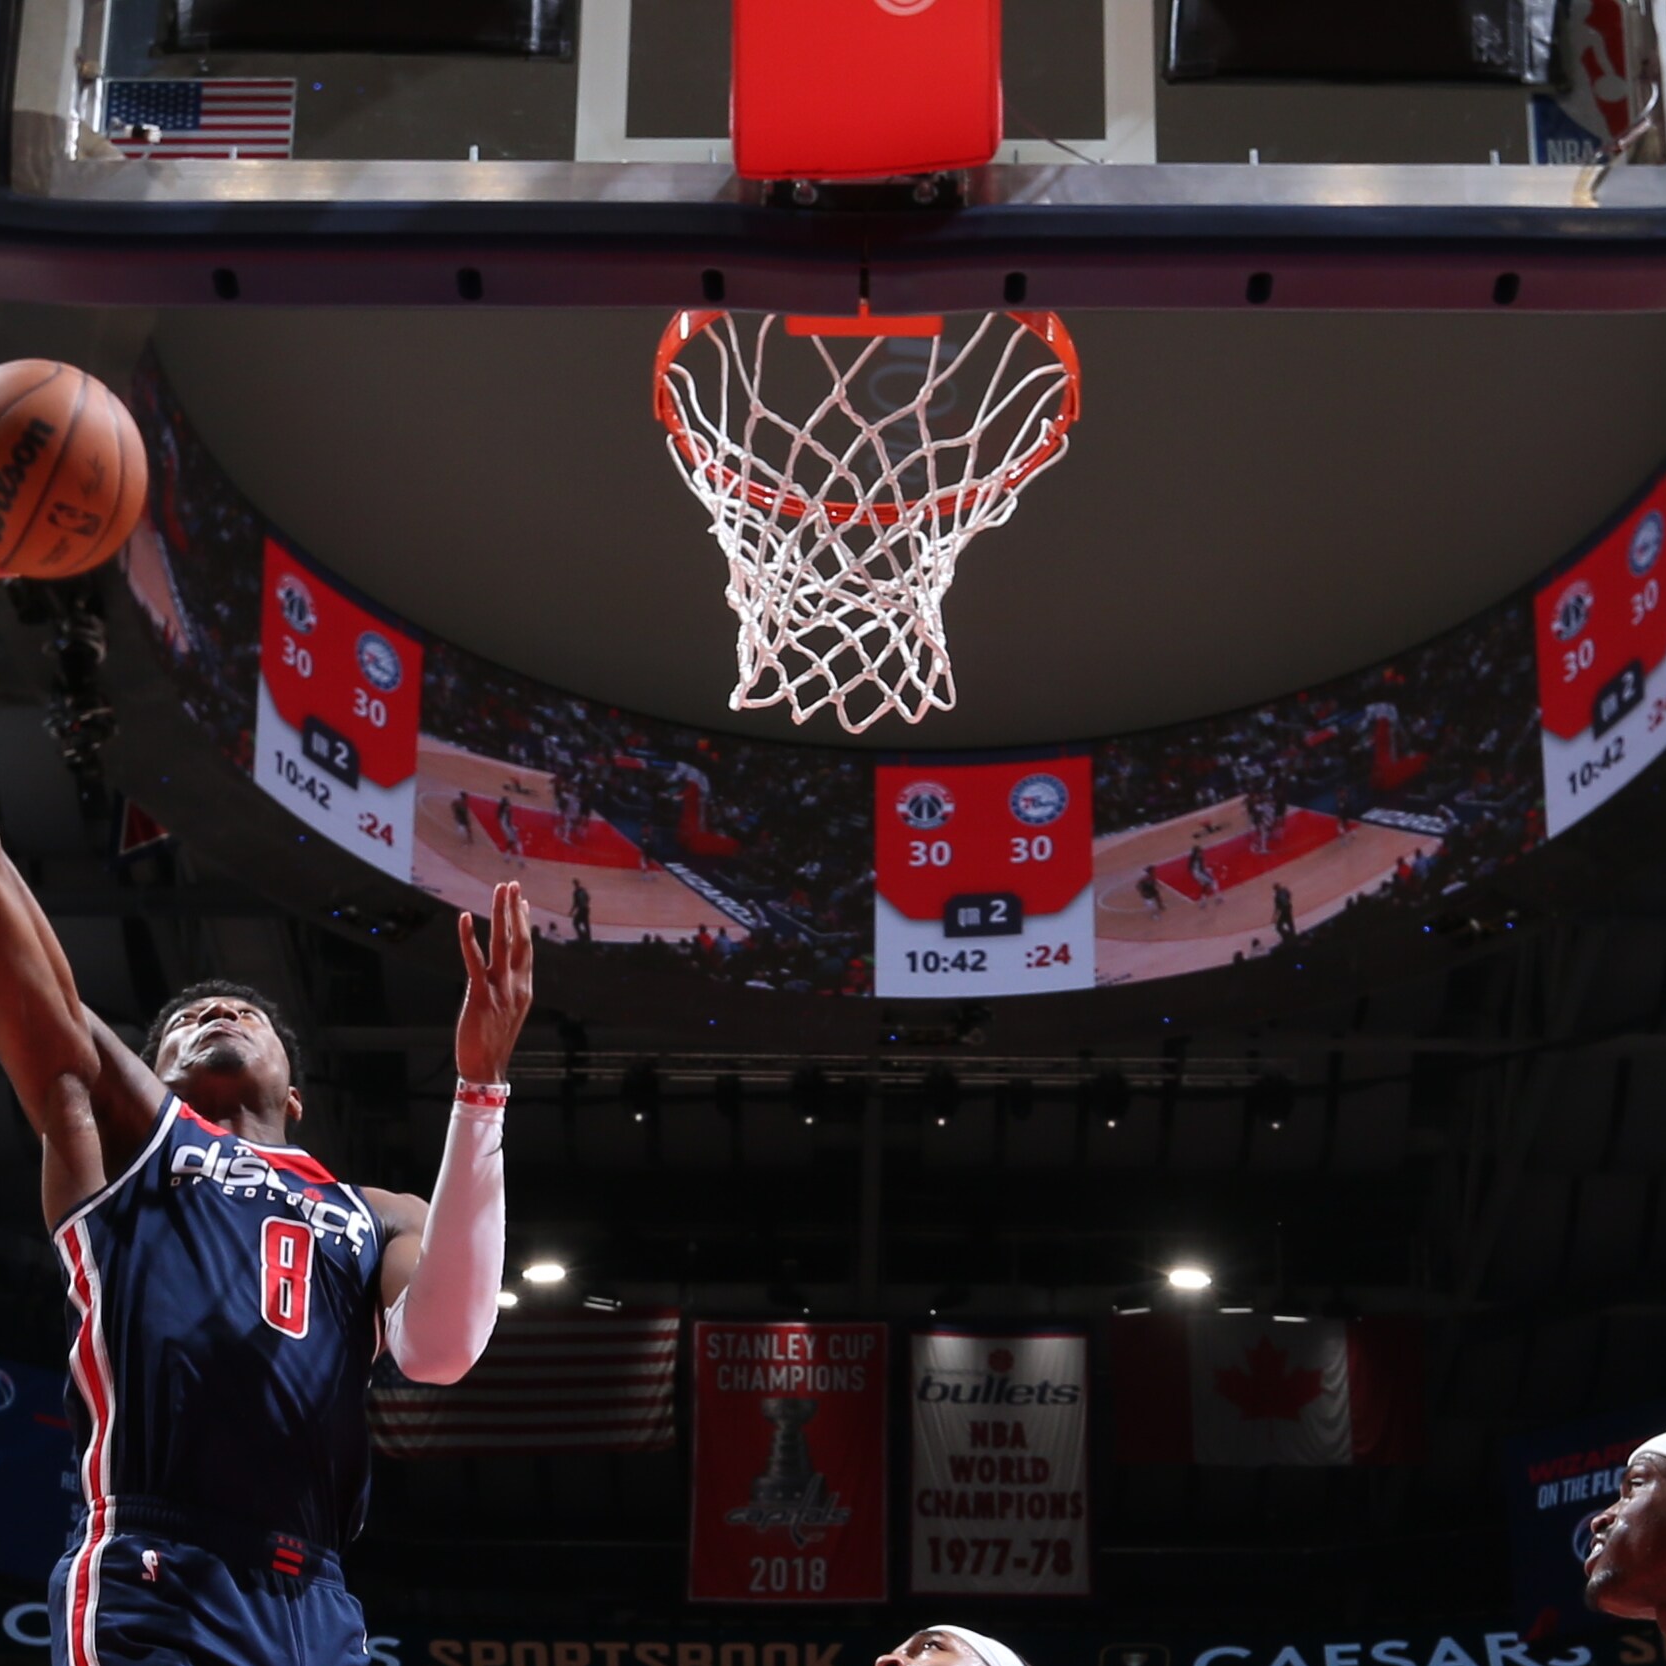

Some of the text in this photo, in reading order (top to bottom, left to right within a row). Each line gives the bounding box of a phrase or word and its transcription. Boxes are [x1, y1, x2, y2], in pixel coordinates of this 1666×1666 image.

[1563, 578, 1660, 682] 30 30
[281, 634, 388, 728] 30 30
[1622, 671, 1636, 700] 2
[333, 741, 349, 770] 2
[1566, 736, 1626, 797] 10:42
[275, 749, 332, 812] 10:42
[908, 835, 1053, 868] 30 30
[989, 899, 1008, 924] 2
[905, 944, 1072, 974] 10:42 :24
[260, 1215, 314, 1339] 8
[706, 1332, 876, 1361] STANLEY CUP
[717, 1365, 867, 1392] CHAMPIONS
[916, 1375, 1082, 1406] bullets
[968, 1420, 1028, 1449] NBA
[948, 1454, 1051, 1485] WORLD
[1537, 1465, 1626, 1510] ON THE FLO
[916, 1488, 1084, 1522] CHAMPIONS
[927, 1536, 1074, 1577] 1977-78
[749, 1556, 827, 1592] 2018
